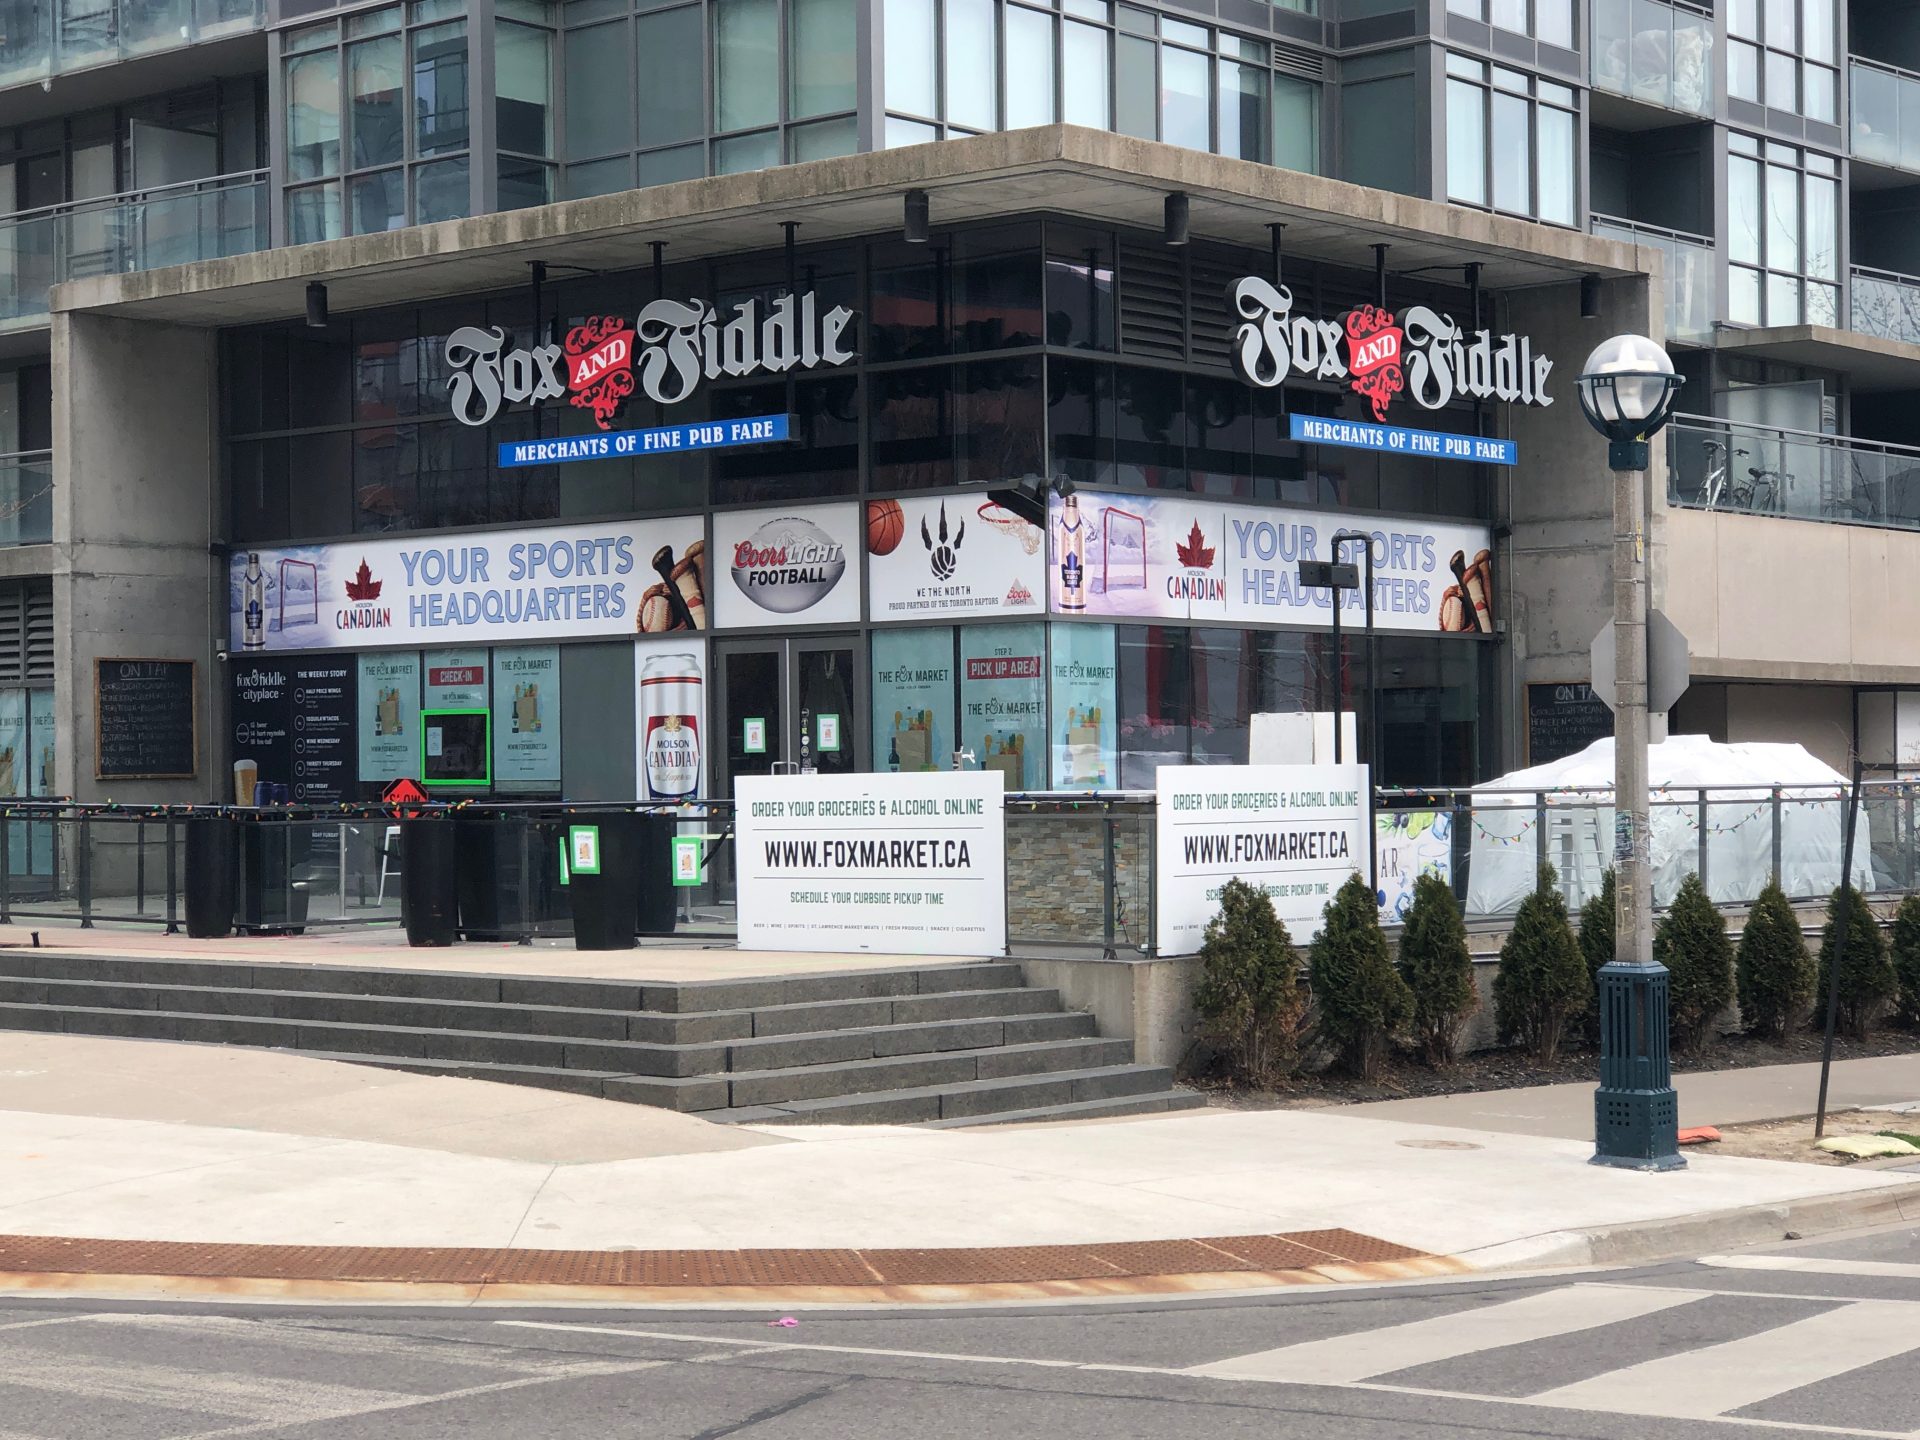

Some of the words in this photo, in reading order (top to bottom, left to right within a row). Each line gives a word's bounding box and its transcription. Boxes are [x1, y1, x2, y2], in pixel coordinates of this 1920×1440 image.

[1236, 276, 1348, 387] Fox
[1355, 335, 1397, 368] AND
[1405, 305, 1554, 410] Fiddle
[445, 326, 566, 426] Fox
[573, 340, 627, 384] AND
[637, 290, 855, 404] Fiddle
[514, 437, 609, 462] MERCHANTS
[615, 436, 637, 452] OF
[643, 431, 681, 450] FINE
[689, 426, 724, 446] PUB
[731, 420, 774, 443] FARE
[1303, 420, 1384, 447] MERCHANTS
[1389, 432, 1406, 448] OF
[1411, 435, 1440, 453] FINE
[1445, 438, 1471, 456] PUB
[1476, 442, 1506, 460] FARE
[734, 540, 787, 569] Coors
[786, 544, 843, 565] LIGHT
[1232, 519, 1318, 563] YOUR
[1336, 527, 1437, 573] SPORTS
[400, 545, 490, 586] YOUR
[509, 535, 634, 581] SPORTS
[748, 567, 827, 586] FOOTBALL
[916, 588, 926, 597] WE
[928, 587, 942, 597] THE
[944, 585, 971, 596] NORTH
[1167, 576, 1224, 601] CANADIAN
[408, 583, 626, 628] HEADQUARTERS
[889, 602, 906, 610] PROUD
[906, 601, 930, 610] PARTNER
[931, 600, 937, 608] OF
[938, 599, 948, 608] THE
[949, 598, 974, 607] TORONTO
[974, 597, 999, 606] RAPTORS
[336, 607, 391, 629] CANADIAN
[994, 648, 1007, 656] STEP
[1008, 647, 1013, 655] 2
[120, 663, 140, 678] ON
[501, 661, 512, 671] THE
[527, 660, 552, 670] MARKET
[878, 671, 893, 683] THE
[895, 665, 913, 682] FOX
[915, 669, 949, 682] MARKET
[971, 661, 993, 676] PICK
[995, 661, 1007, 675] UP
[1010, 660, 1036, 675] AREA
[1055, 665, 1067, 678] THE
[1070, 660, 1085, 678] FOX
[1086, 666, 1114, 679] MARKET
[440, 670, 472, 683] CHECK-IN
[242, 687, 279, 702] cityplace
[1555, 685, 1574, 700] ON
[967, 703, 983, 715] THE
[985, 697, 1004, 715] FOX
[1006, 702, 1040, 714] MARKET
[657, 740, 689, 748] MOLSON
[650, 751, 696, 767] CANADIAN
[751, 801, 784, 817] ORDER
[788, 801, 815, 817] YOUR
[818, 799, 875, 817] GROCERIES
[879, 799, 887, 816] &
[891, 799, 940, 816] ALCOHOL
[944, 798, 984, 815] ONLINE
[1173, 793, 1202, 811] ORDER
[1205, 793, 1229, 810] YOUR
[1231, 792, 1278, 809] GROCERIES
[1280, 792, 1287, 808] &
[1289, 791, 1327, 808] ALCOHOL
[1329, 791, 1359, 807] ONLINE
[765, 840, 971, 868] WWW.FOXMARKET.CA
[1184, 830, 1349, 865] WWW.FOXMARKET.CA
[790, 891, 829, 904] SCHEDULE
[831, 892, 851, 904] YOUR
[853, 892, 891, 904] CURBSIDE
[893, 892, 922, 905] PICKUP
[925, 893, 944, 905] TIME
[1290, 883, 1313, 897] PICKUP
[1315, 882, 1329, 895] TIME
